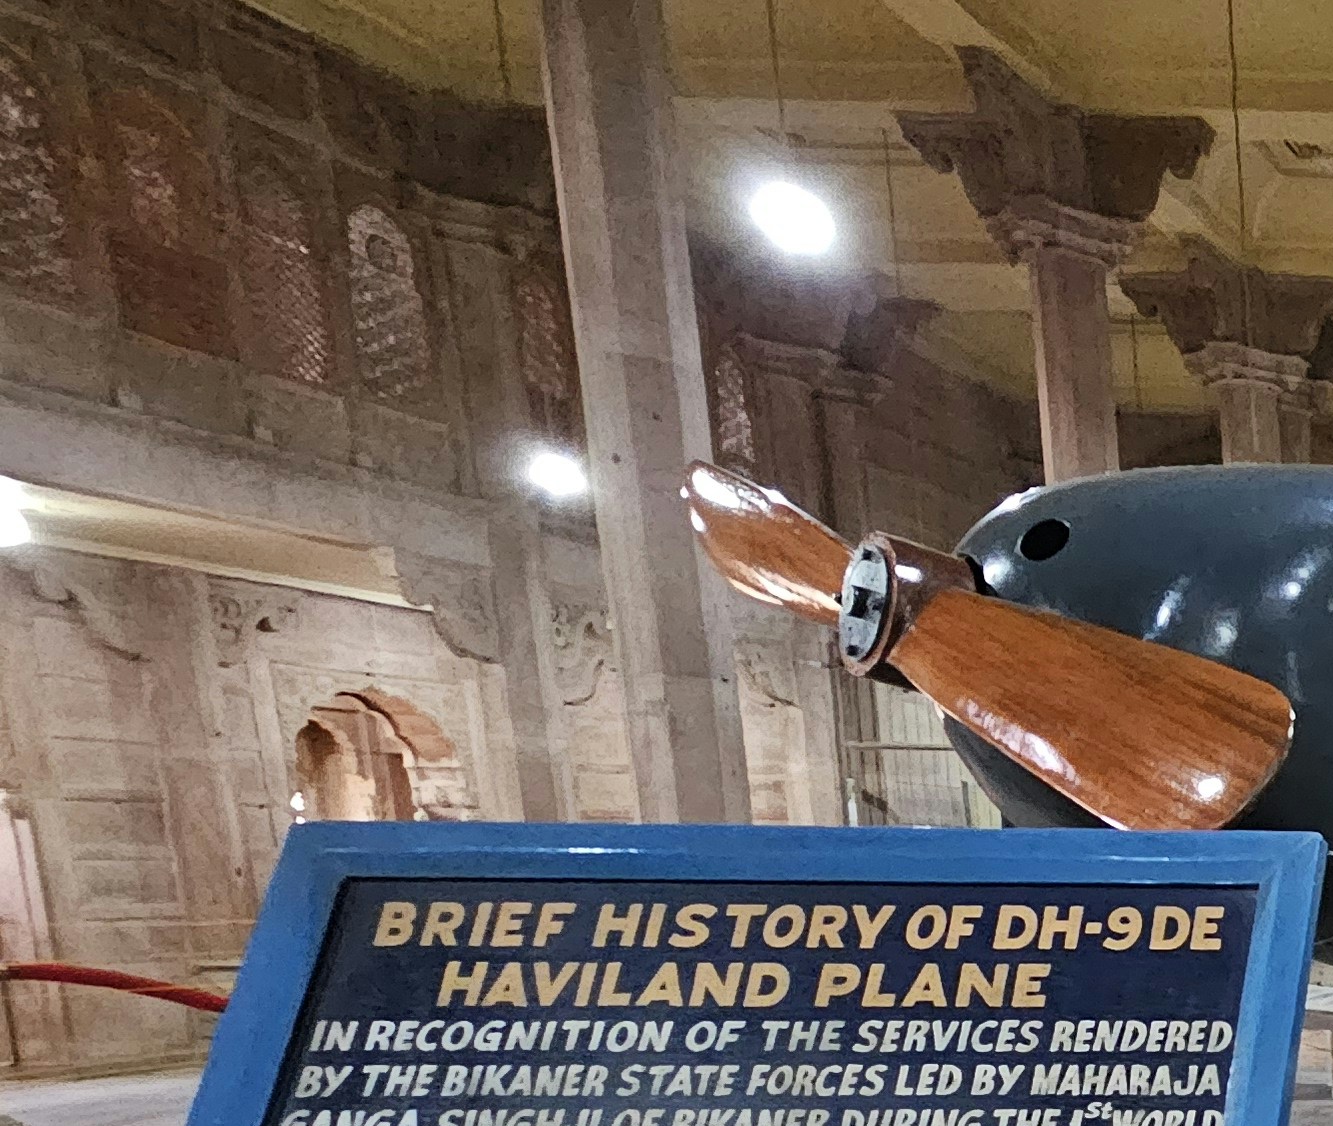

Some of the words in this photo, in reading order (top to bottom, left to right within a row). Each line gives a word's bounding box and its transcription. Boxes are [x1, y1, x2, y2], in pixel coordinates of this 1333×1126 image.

[373, 902, 577, 947] BRIEF
[592, 903, 896, 948] HISTORY
[906, 905, 983, 949] OF
[437, 961, 790, 1007] HAVILAND
[815, 963, 1051, 1007] PLANE
[310, 1020, 359, 1051] IN
[365, 1020, 674, 1052] RECOGNITION
[685, 1021, 746, 1052] OF
[762, 1021, 845, 1051] THE
[852, 1020, 1043, 1052] SERVICES
[1050, 1020, 1233, 1052] RENDERED
[295, 1066, 353, 1098] BY
[363, 1064, 437, 1096] THE
[441, 1064, 608, 1096] BIKANER
[616, 1064, 739, 1096] STATE
[746, 1064, 888, 1096] FORCES
[895, 1064, 962, 1096] LED
[971, 1064, 1025, 1095] BY
[1031, 1064, 1220, 1096] MAHARAJA
